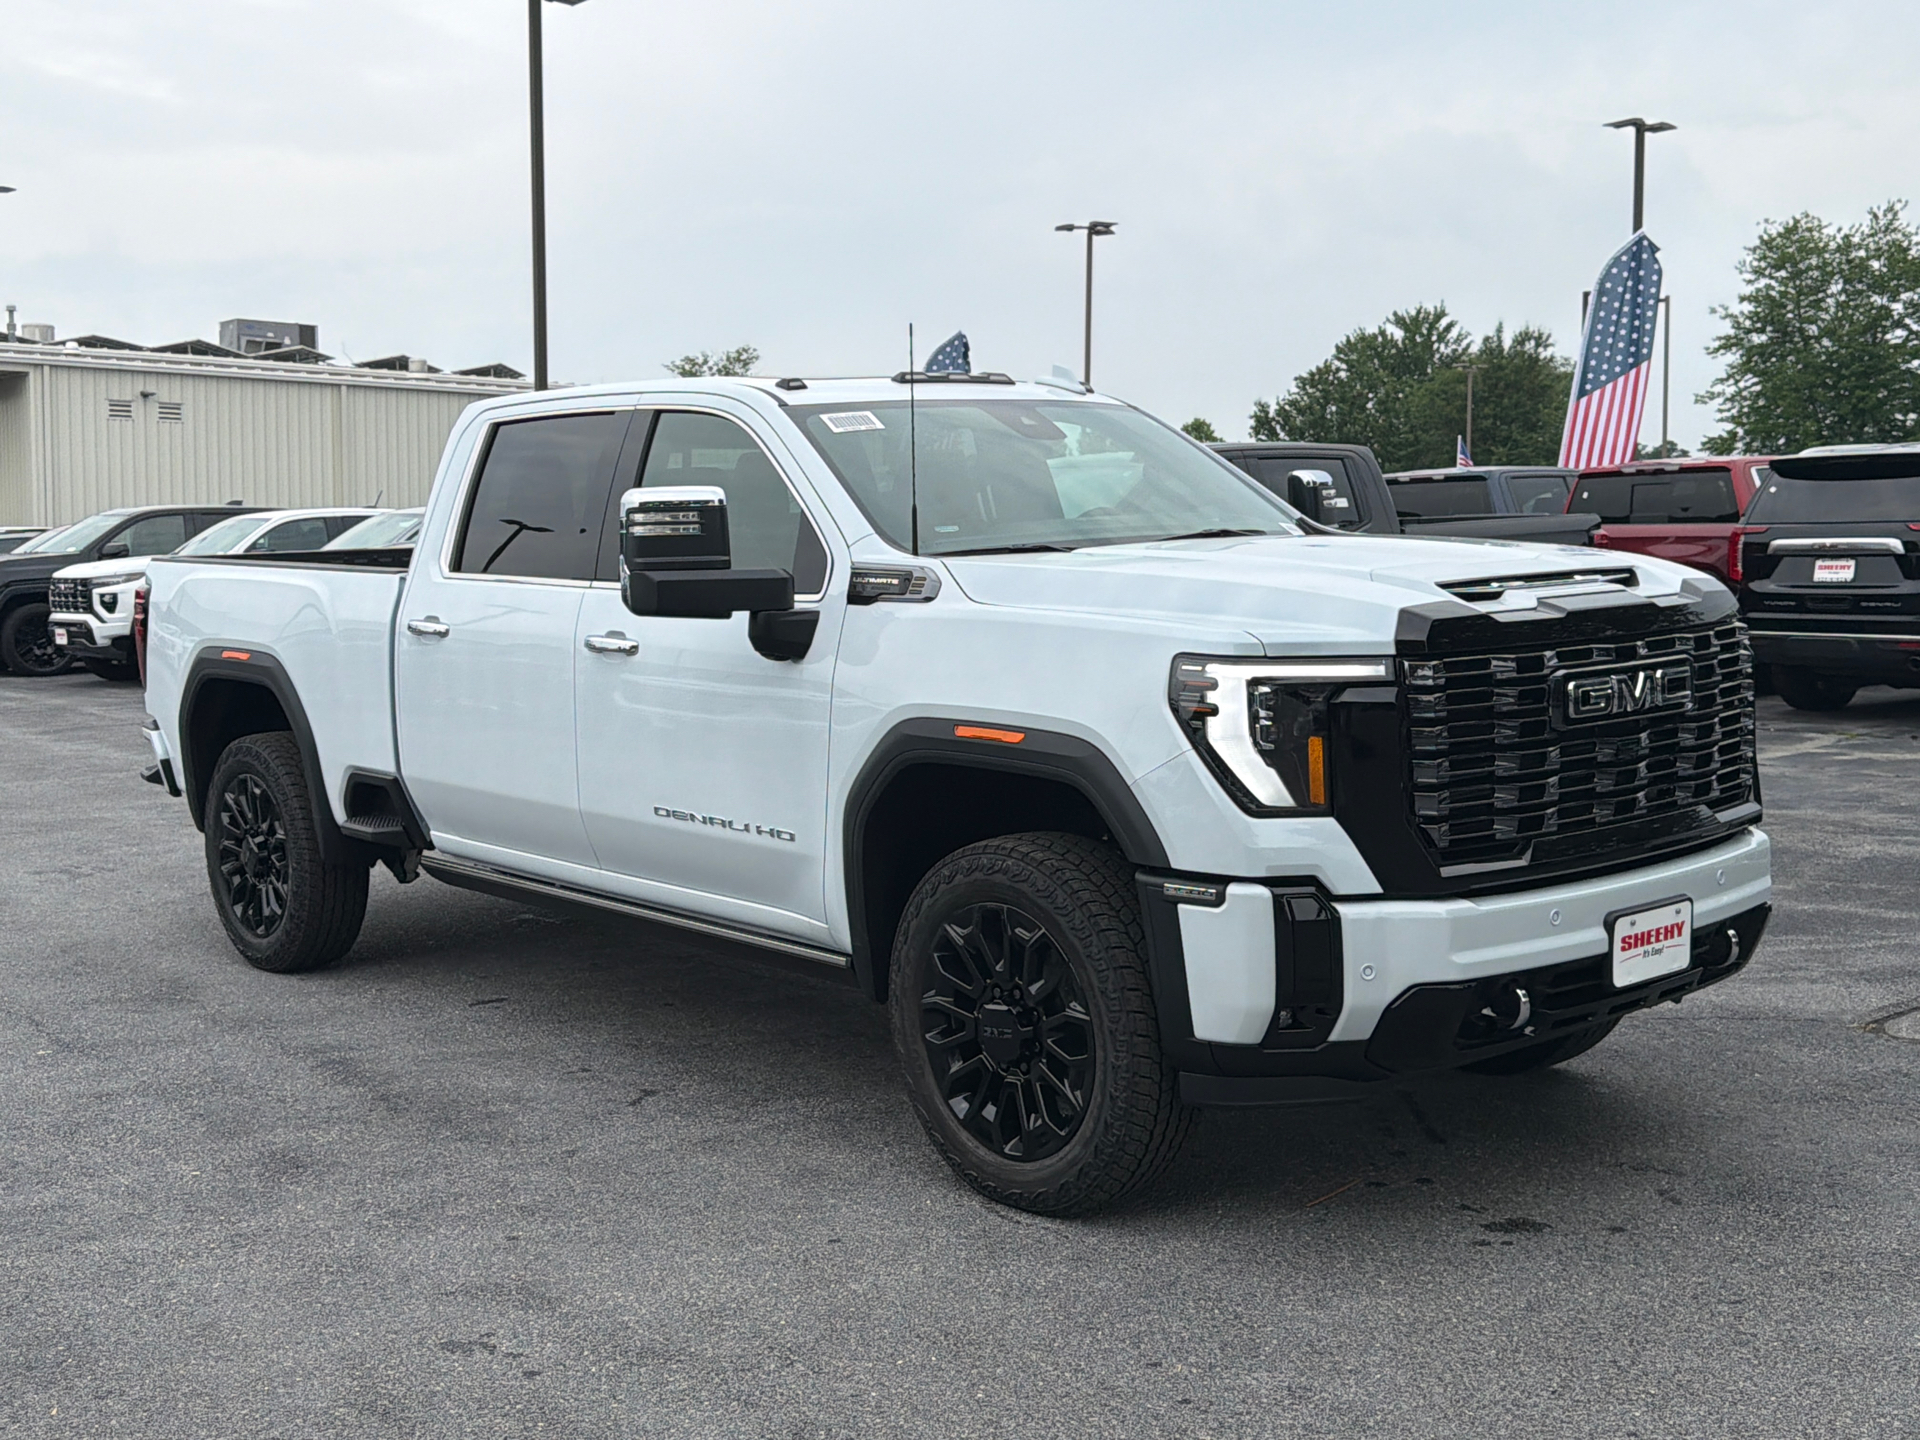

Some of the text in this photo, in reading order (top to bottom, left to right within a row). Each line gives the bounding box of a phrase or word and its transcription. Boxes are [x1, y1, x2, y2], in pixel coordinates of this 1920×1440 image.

[852, 576, 900, 585] ULTIMATE
[1567, 666, 1692, 718] GMC
[653, 804, 796, 843] DENALI HD
[1620, 920, 1686, 953] SHEEHY
